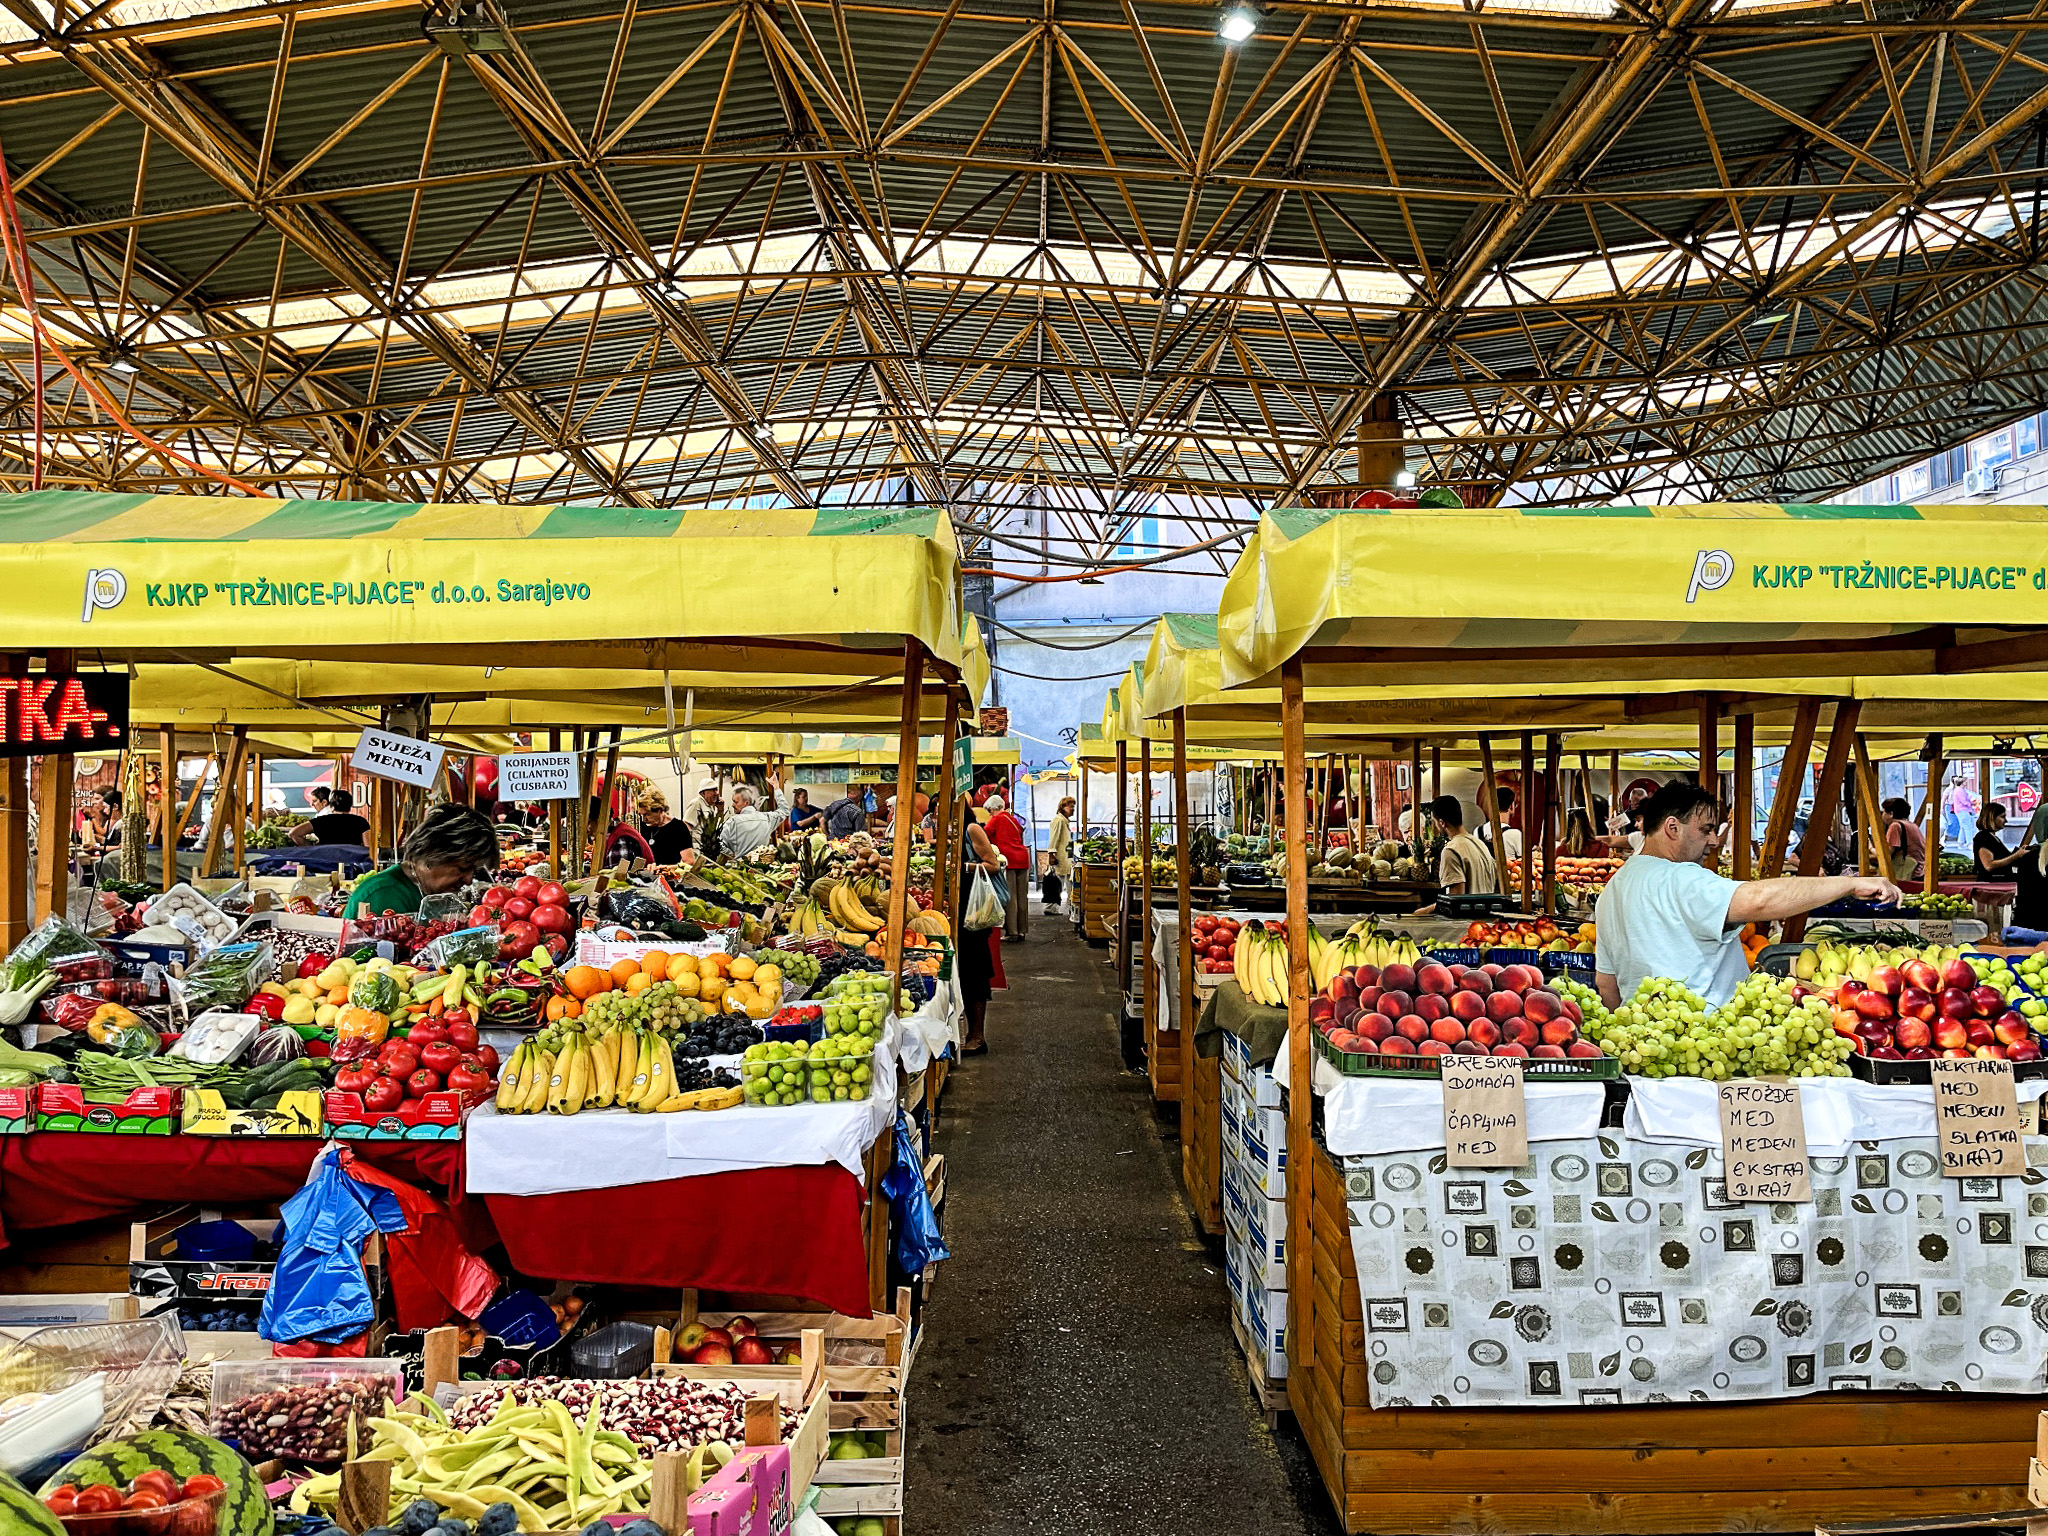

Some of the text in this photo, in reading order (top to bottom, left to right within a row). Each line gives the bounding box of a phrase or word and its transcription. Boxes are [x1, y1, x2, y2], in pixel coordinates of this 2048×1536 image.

[1753, 565, 1812, 588] KJKP
[1819, 560, 2026, 590] "TRŽNICE-PIJACE"
[146, 583, 208, 606] KJKP
[215, 577, 424, 605] "TRŽNICE-PIJACE"
[431, 580, 490, 603] d.o.o.
[497, 578, 591, 606] Sarajevo
[368, 736, 432, 761] SVJEŽA
[366, 750, 423, 775] MENTA
[505, 757, 571, 768] KORIJANDER
[507, 768, 569, 782] (CILANTRO)
[854, 768, 880, 776] Hasan
[510, 780, 567, 793] (CUSBARA)
[121, 962, 134, 970] AP.
[1441, 1055, 1523, 1072] BRESKVA
[1940, 1082, 1979, 1097] MED
[1730, 1109, 1775, 1127] MED
[1942, 1104, 2005, 1119] MEDENI
[1731, 1137, 1796, 1153] MEDENI
[1949, 1130, 2018, 1145] SLATKA
[1457, 1141, 1497, 1155] MED
[1943, 1147, 2003, 1168] BIRAJ
[1733, 1162, 1804, 1178] EKSTRA
[1733, 1181, 1792, 1197] BIRAJ
